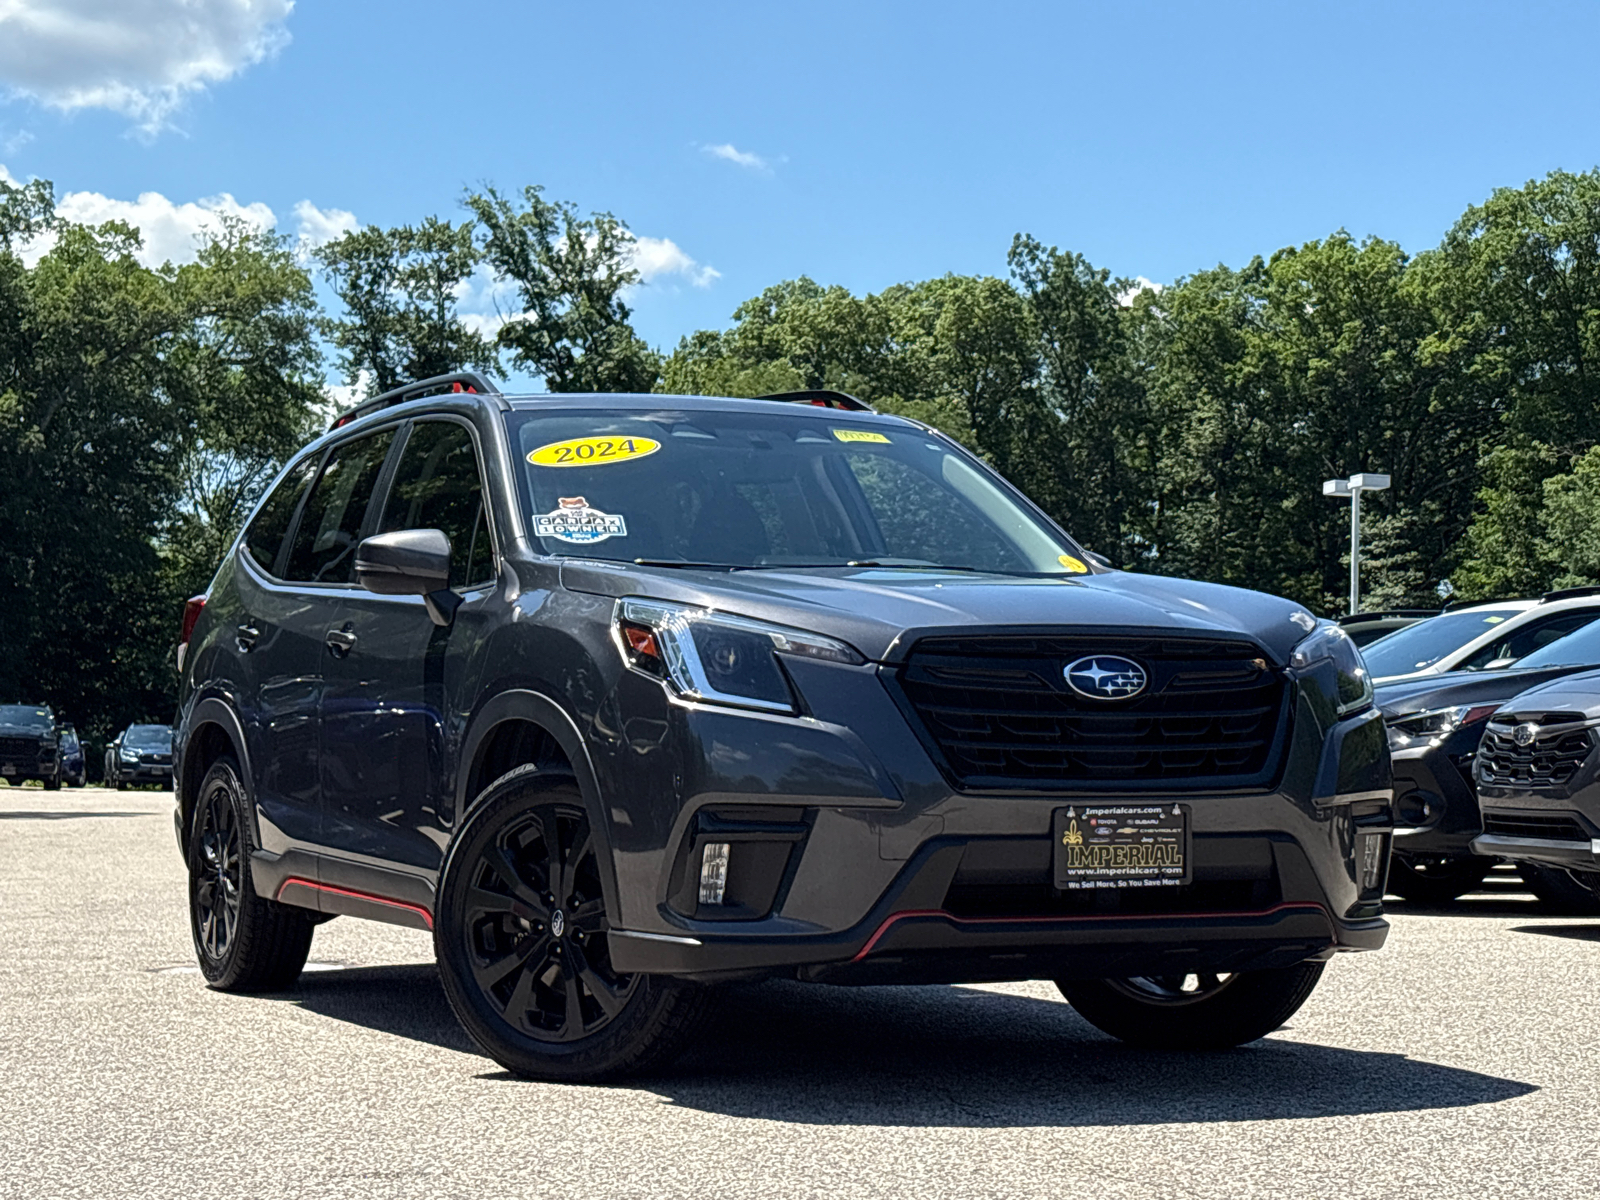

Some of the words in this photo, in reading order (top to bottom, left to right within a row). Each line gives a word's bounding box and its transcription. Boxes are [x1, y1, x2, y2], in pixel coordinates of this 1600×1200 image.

[554, 439, 639, 463] 2024
[539, 517, 618, 525] CARFAX
[1086, 807, 1162, 816] Imperialcars.com
[1068, 844, 1183, 867] IMPERIAL
[1096, 880, 1116, 888] More,
